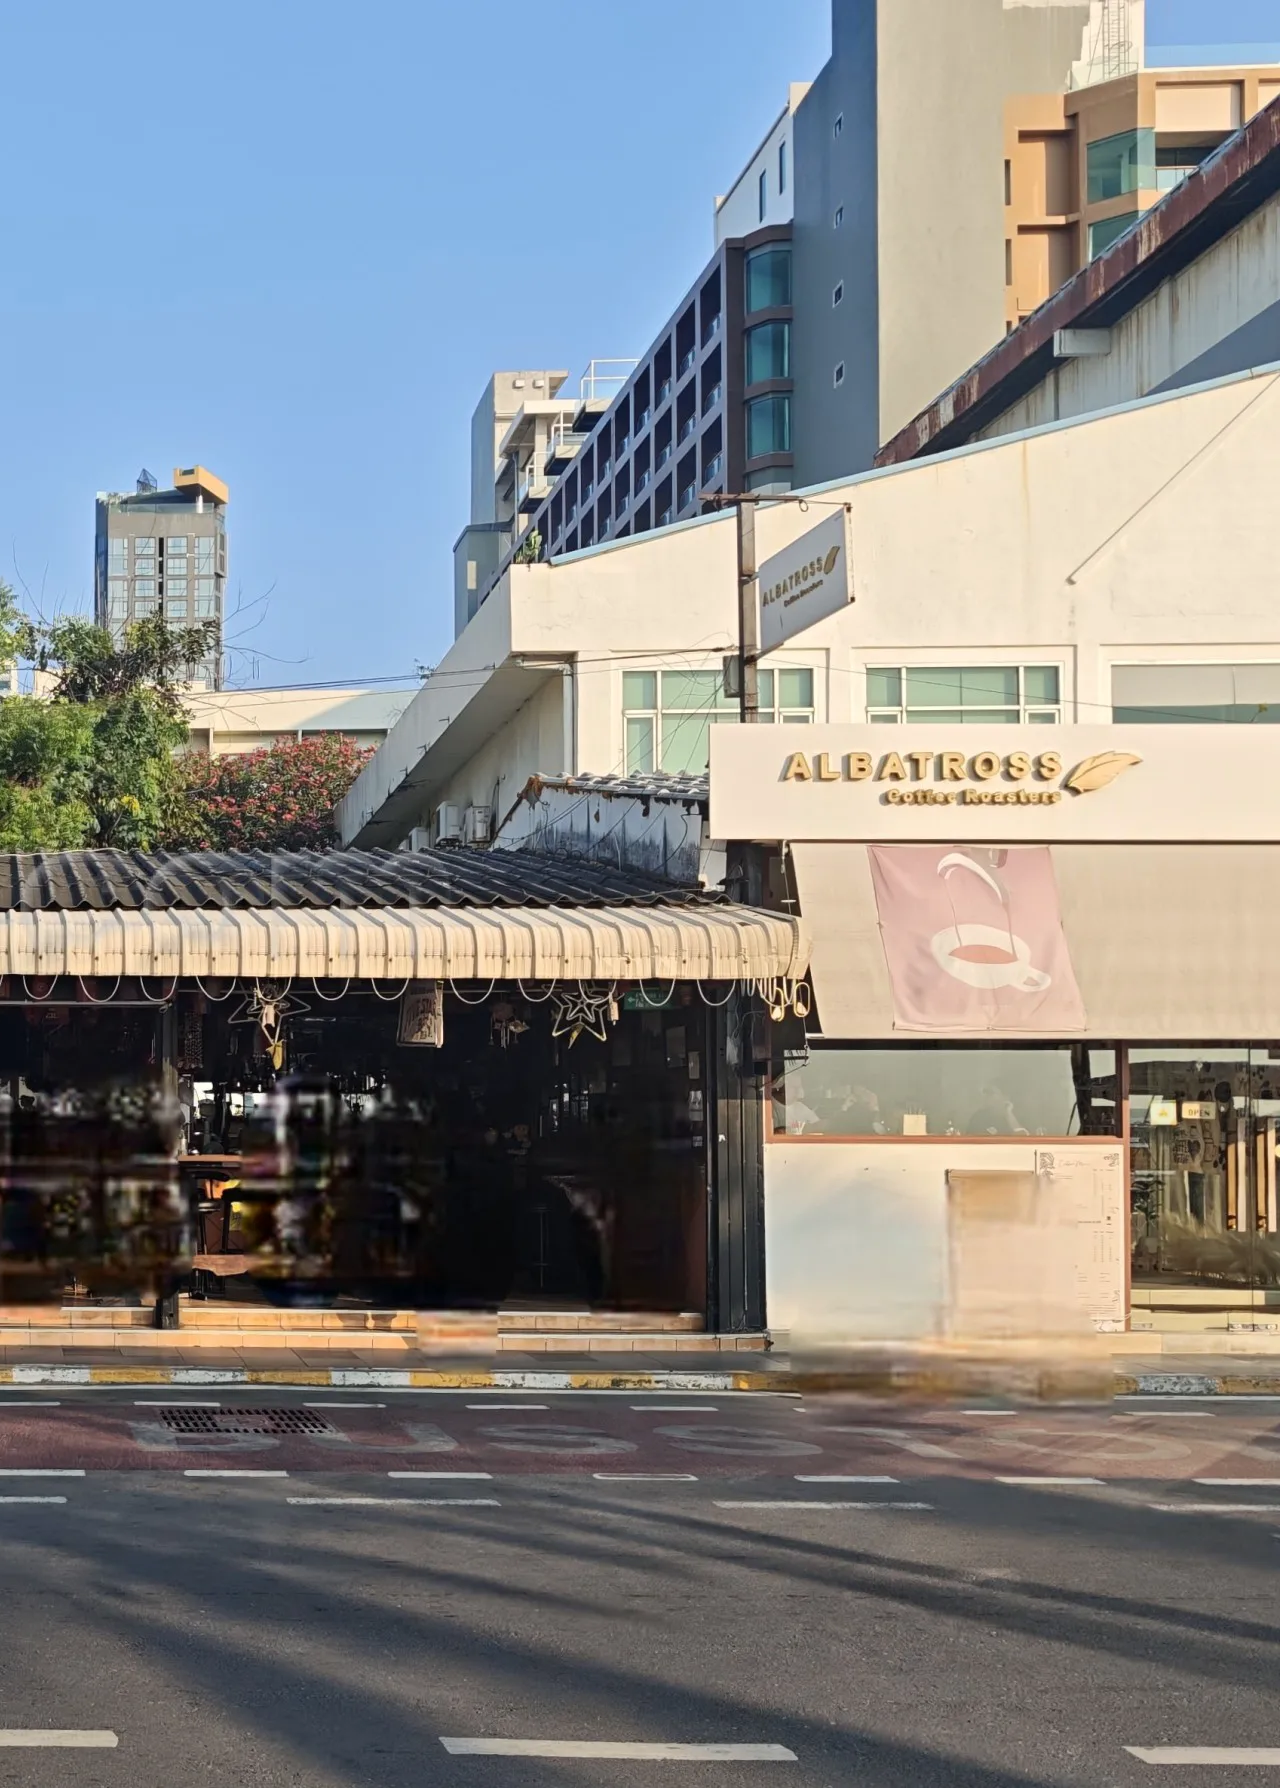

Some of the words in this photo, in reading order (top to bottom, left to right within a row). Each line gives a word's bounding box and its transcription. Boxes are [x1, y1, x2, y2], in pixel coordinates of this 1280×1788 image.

[762, 556, 823, 607] ALBATROSS
[782, 752, 1062, 781] ALBATROSS
[883, 788, 957, 805] Coffee
[964, 788, 1062, 805] Roasters
[1188, 1109, 1210, 1117] OPEN
